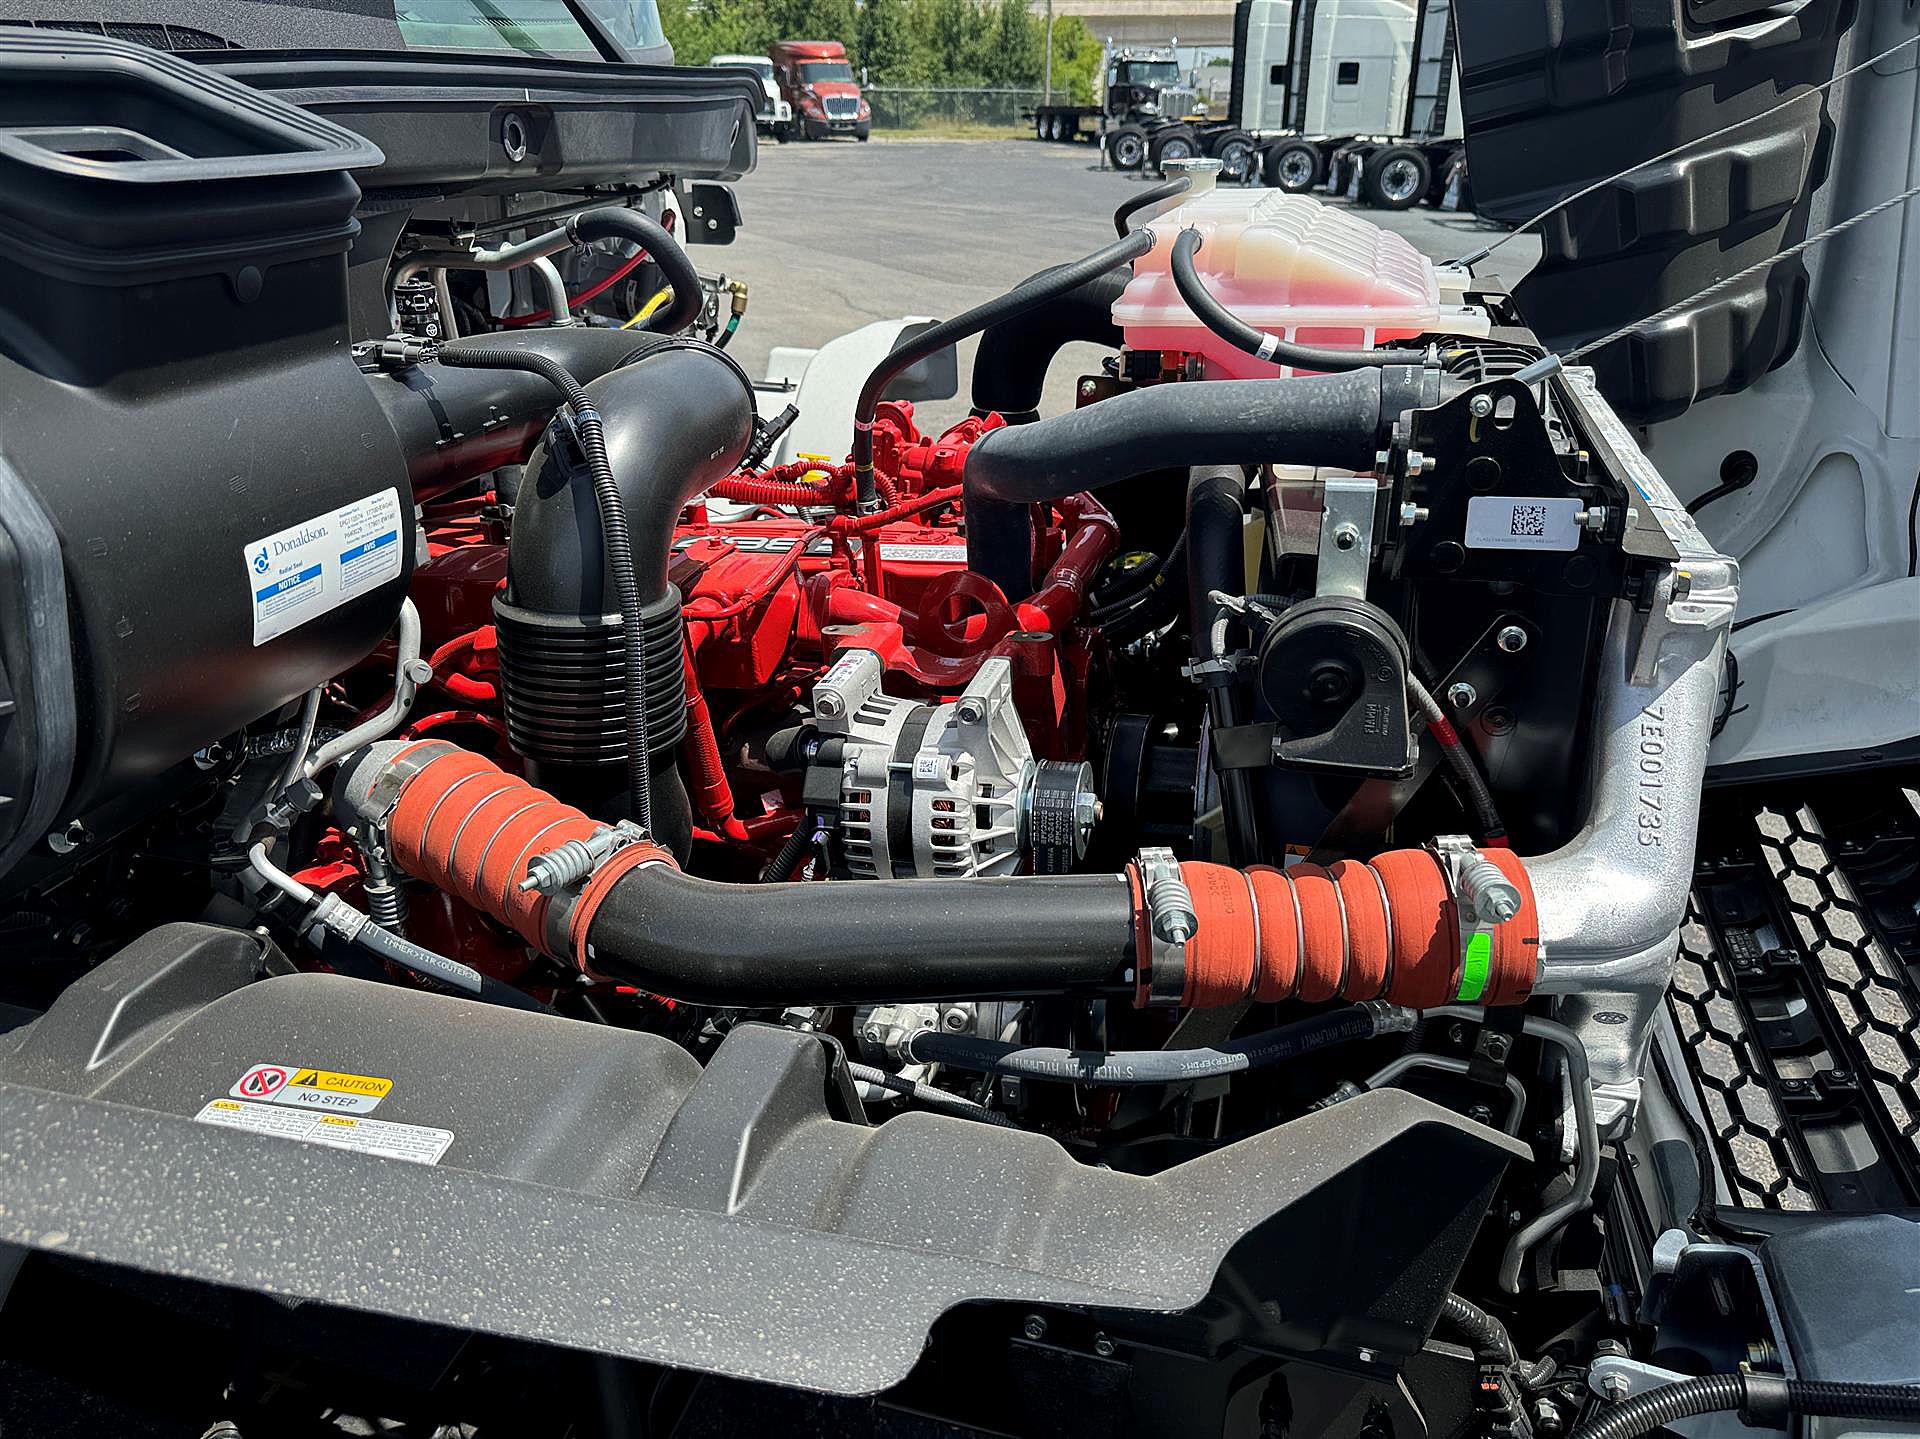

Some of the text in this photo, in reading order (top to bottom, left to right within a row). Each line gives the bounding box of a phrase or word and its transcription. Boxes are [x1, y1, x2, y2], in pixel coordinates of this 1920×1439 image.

[363, 540, 376, 553] AVIS
[278, 575, 301, 591] NOTICE
[325, 1076, 387, 1092] CAUTION
[298, 1093, 359, 1108] NO STEP
